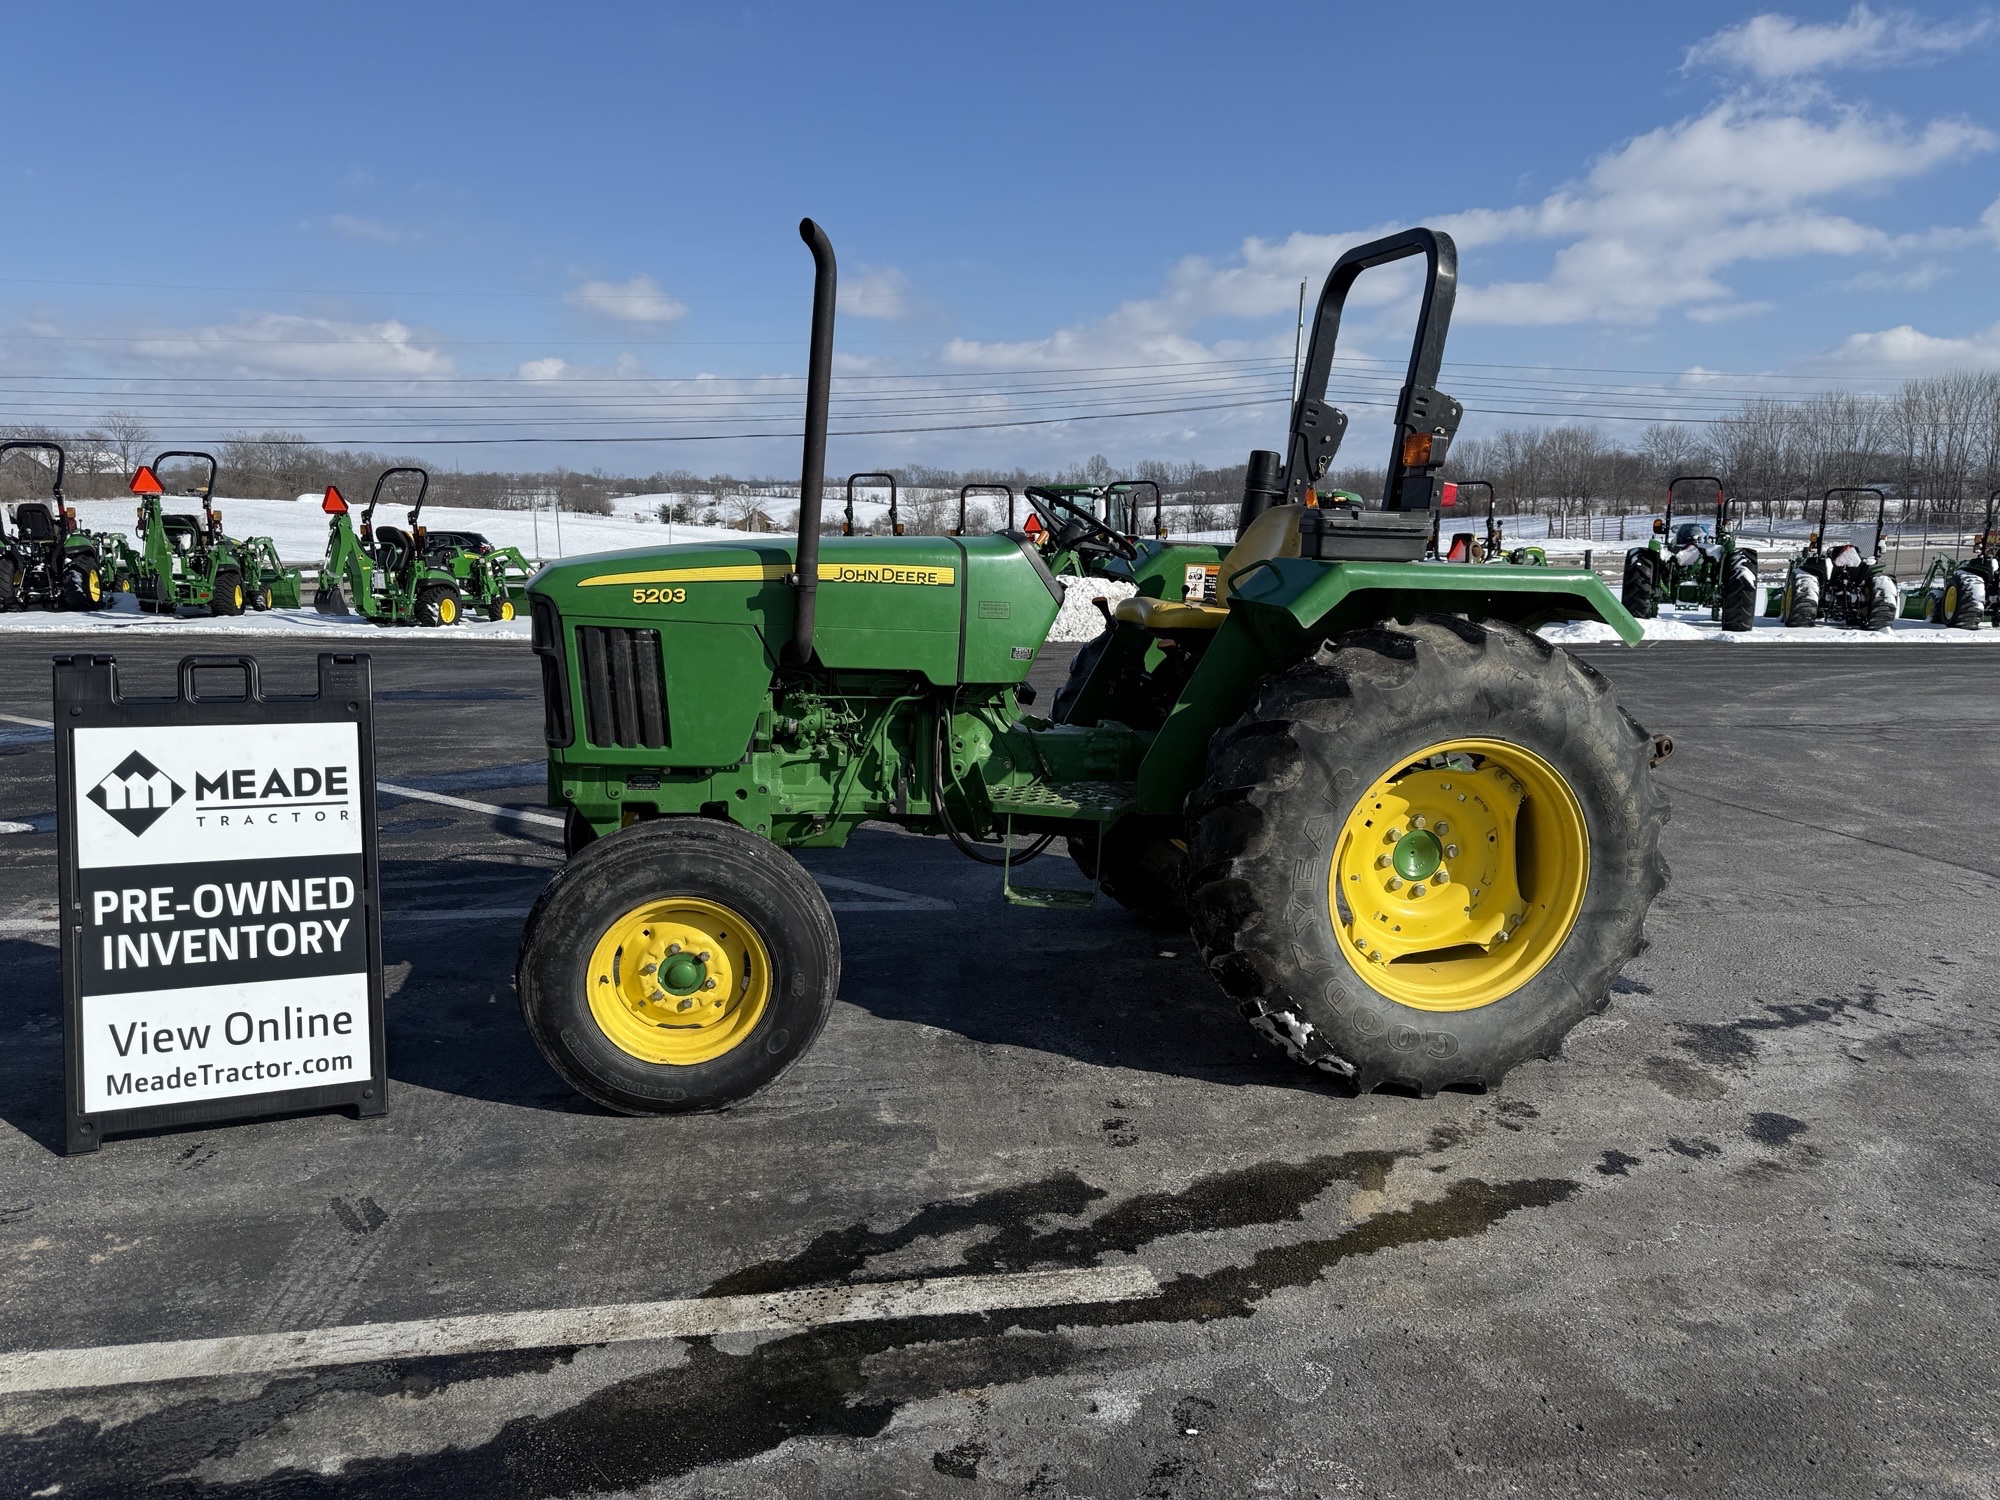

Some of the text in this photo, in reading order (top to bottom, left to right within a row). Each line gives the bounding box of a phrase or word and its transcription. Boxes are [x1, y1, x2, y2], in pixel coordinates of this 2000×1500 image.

[834, 567, 938, 584] JOHN DEERE
[632, 588, 687, 605] 5203
[196, 766, 348, 801] MEADE
[196, 810, 349, 827] TRACTOR
[94, 876, 355, 926] PRE-OWNED
[103, 918, 351, 971] INVENTORY
[109, 1006, 352, 1057] View Online
[107, 1055, 352, 1096] MeadeTractor.com
